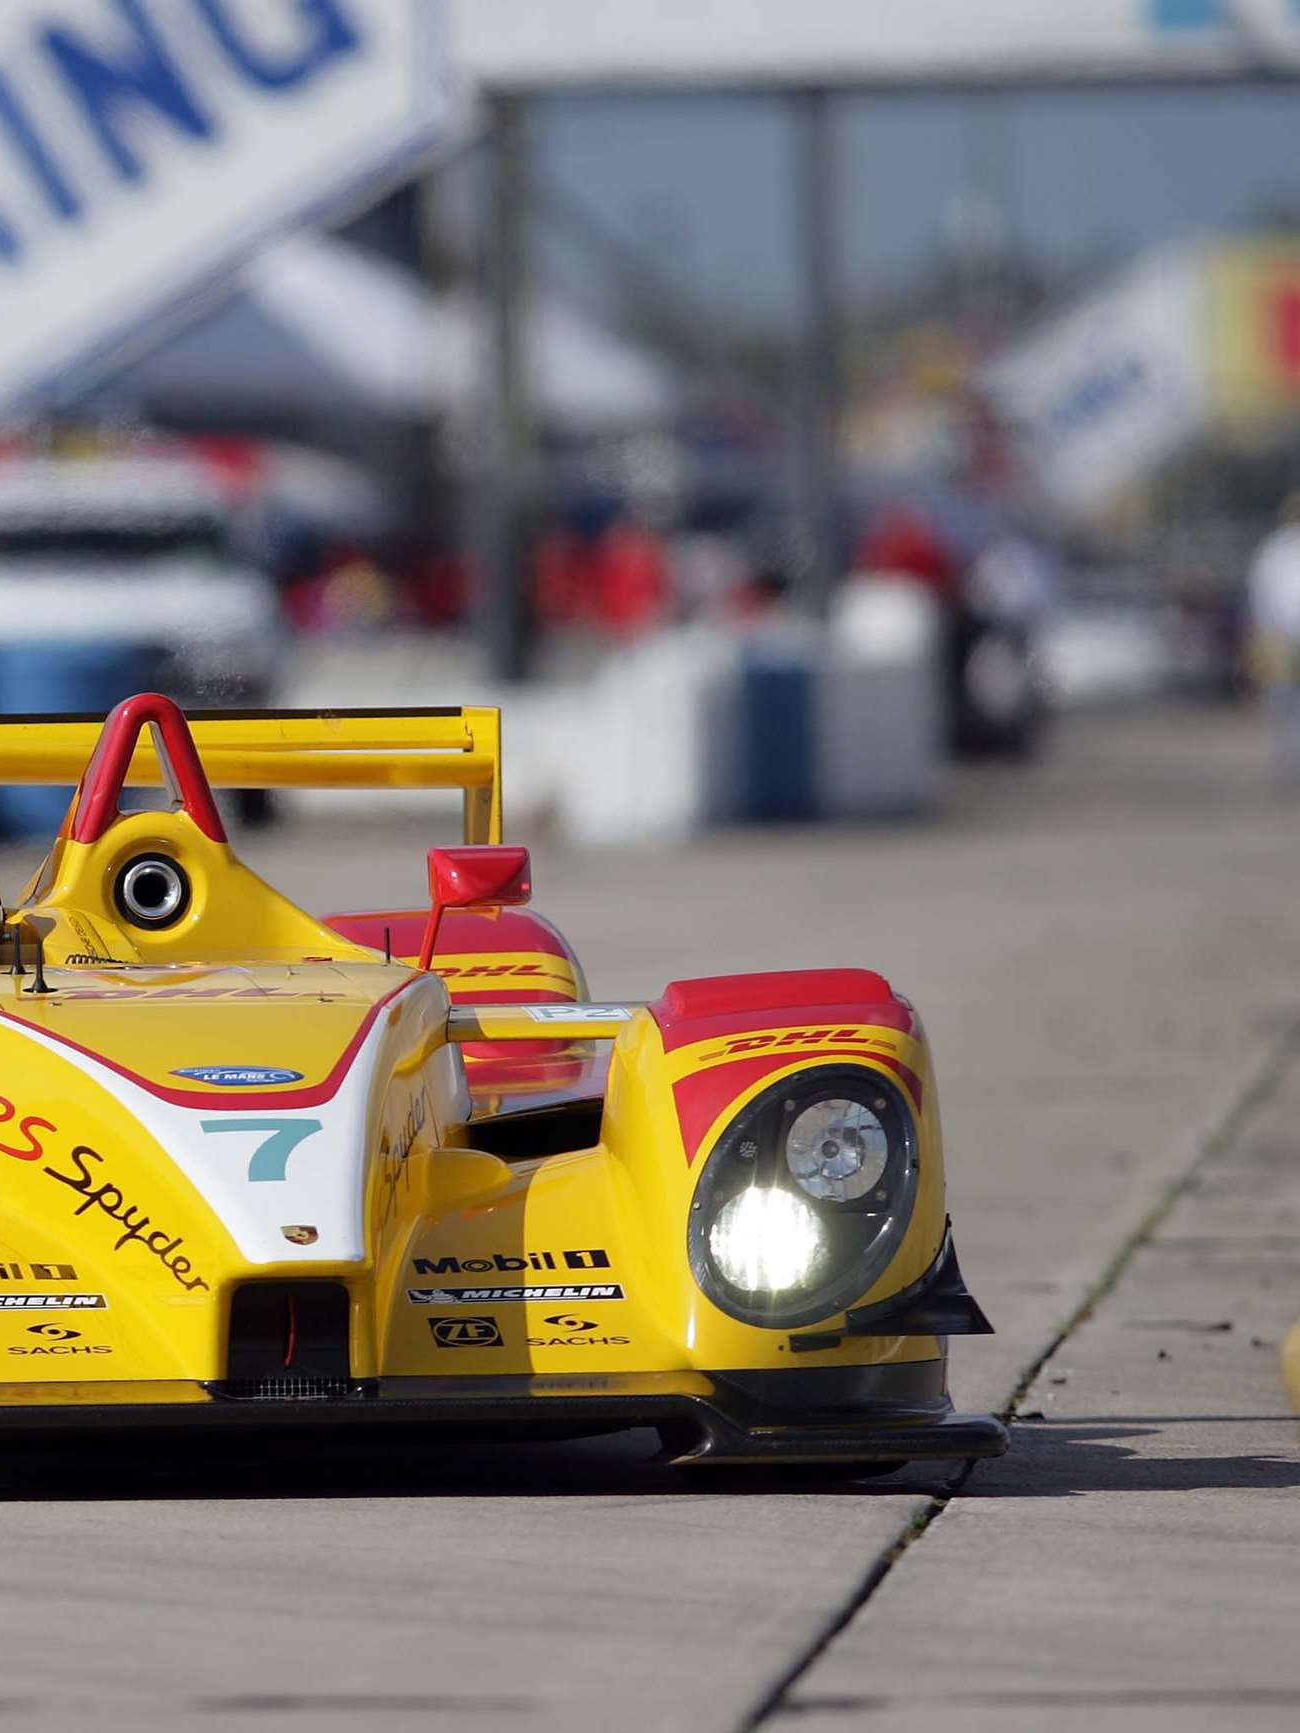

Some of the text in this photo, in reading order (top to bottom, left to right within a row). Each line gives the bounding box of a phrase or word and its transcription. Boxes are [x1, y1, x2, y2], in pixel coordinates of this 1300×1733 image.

[432, 964, 549, 977] DHL
[58, 987, 299, 1000] DHL
[725, 1029, 870, 1055] DHL
[200, 1118, 324, 1183] 7
[43, 1145, 210, 1293] Spyder
[412, 1252, 557, 1275] Mobil
[461, 1285, 616, 1299] MICHELIN
[439, 1323, 488, 1341] ZF
[525, 1336, 632, 1347] SACHS
[7, 1345, 114, 1356] SACHS
